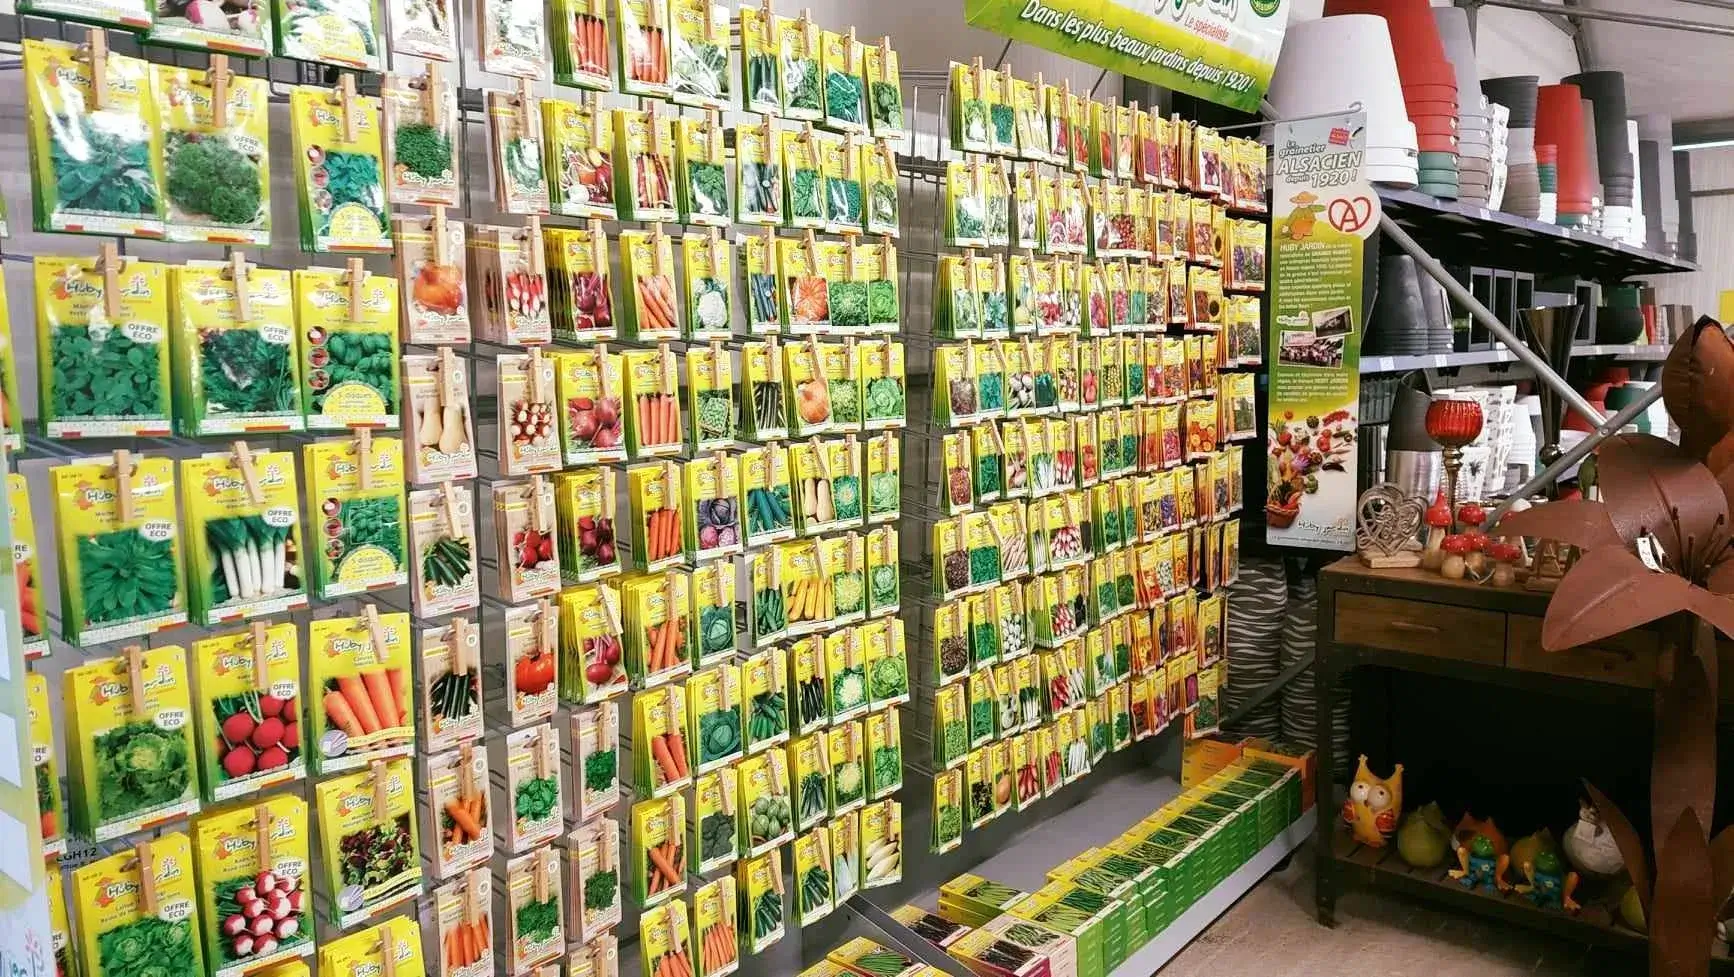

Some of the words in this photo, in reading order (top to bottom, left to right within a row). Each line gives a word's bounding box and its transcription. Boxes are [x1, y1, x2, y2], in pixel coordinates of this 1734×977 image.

[1021, 0, 1064, 28] Dans
[1060, 10, 1084, 35] les
[1076, 19, 1113, 45] plus
[1109, 27, 1151, 58] beaux
[1142, 41, 1191, 71] jardins
[1185, 57, 1224, 83] depuis
[1276, 151, 1362, 175] ALSACIEN
[1311, 169, 1350, 188] 1920
[1280, 243, 1298, 252] HUBY
[128, 323, 159, 334] OFFRE
[263, 326, 289, 336] OFFRE
[132, 331, 153, 340] ECO
[267, 334, 285, 343] ECO
[145, 521, 172, 531] OFFRE
[149, 529, 167, 538] ECO
[273, 682, 294, 690] OFFRE
[277, 689, 291, 697] ECO
[160, 710, 184, 720] OFFRE
[164, 719, 180, 727] ECO
[277, 862, 302, 870] OFFRE
[281, 868, 298, 876] ECO
[163, 902, 189, 913] OFFRE
[168, 911, 185, 919] ECO
